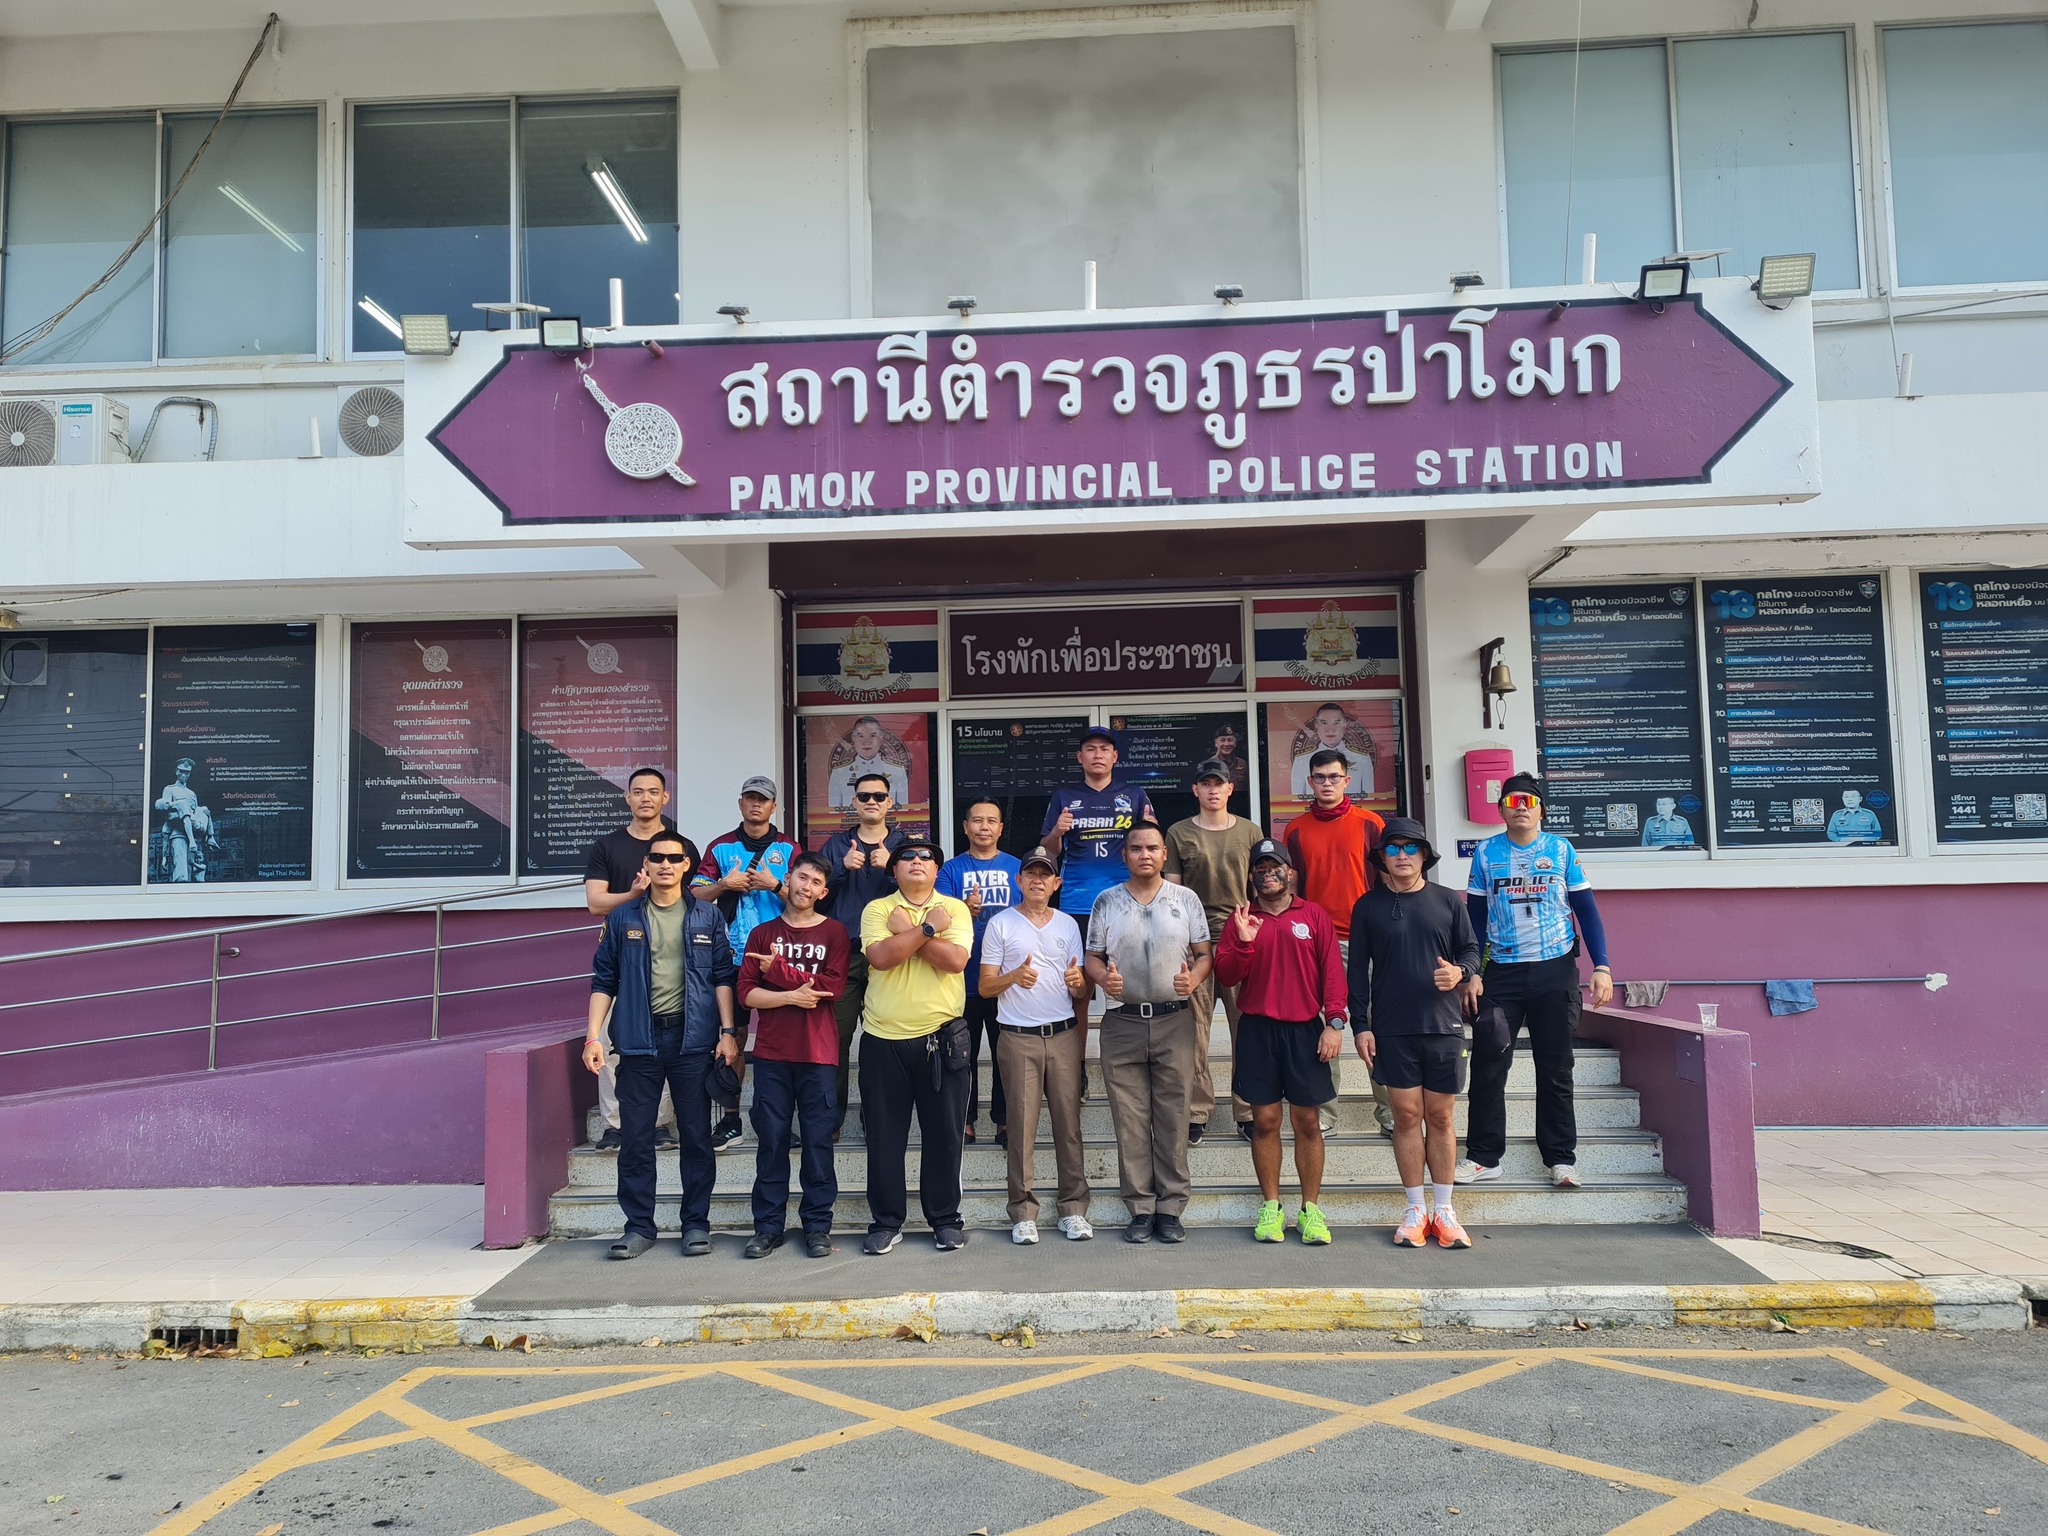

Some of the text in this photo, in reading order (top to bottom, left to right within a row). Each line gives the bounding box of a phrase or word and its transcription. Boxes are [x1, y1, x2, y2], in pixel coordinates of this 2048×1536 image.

[720, 307, 1622, 450] สถานีตำรวจภูธรป่าโมก
[730, 440, 1624, 511] PAMOK PROVINCIAL POLICE STATION
[1711, 588, 1853, 619] 18 กลโกง ของมิจฉาชีพ
[1928, 581, 1973, 611] 18
[1974, 581, 2010, 592] กลโกง
[1976, 595, 2032, 608] หลอกเหยื่อ
[1530, 597, 1570, 626] 18
[1758, 603, 1814, 616] หลอกเหยื่อ
[961, 626, 1233, 676] โรงพักเพื่อประชาชน
[402, 678, 463, 693] อุดมคติตำรวจ
[956, 726, 1003, 737] 15 นโยบาย
[1731, 810, 1755, 818] 1441
[1951, 806, 1976, 814] 1441
[1114, 815, 1132, 829] 26
[1547, 815, 1570, 824] 1441
[1095, 841, 1108, 858] 15
[963, 870, 1009, 888] FLYER
[1493, 876, 1558, 895] POICE
